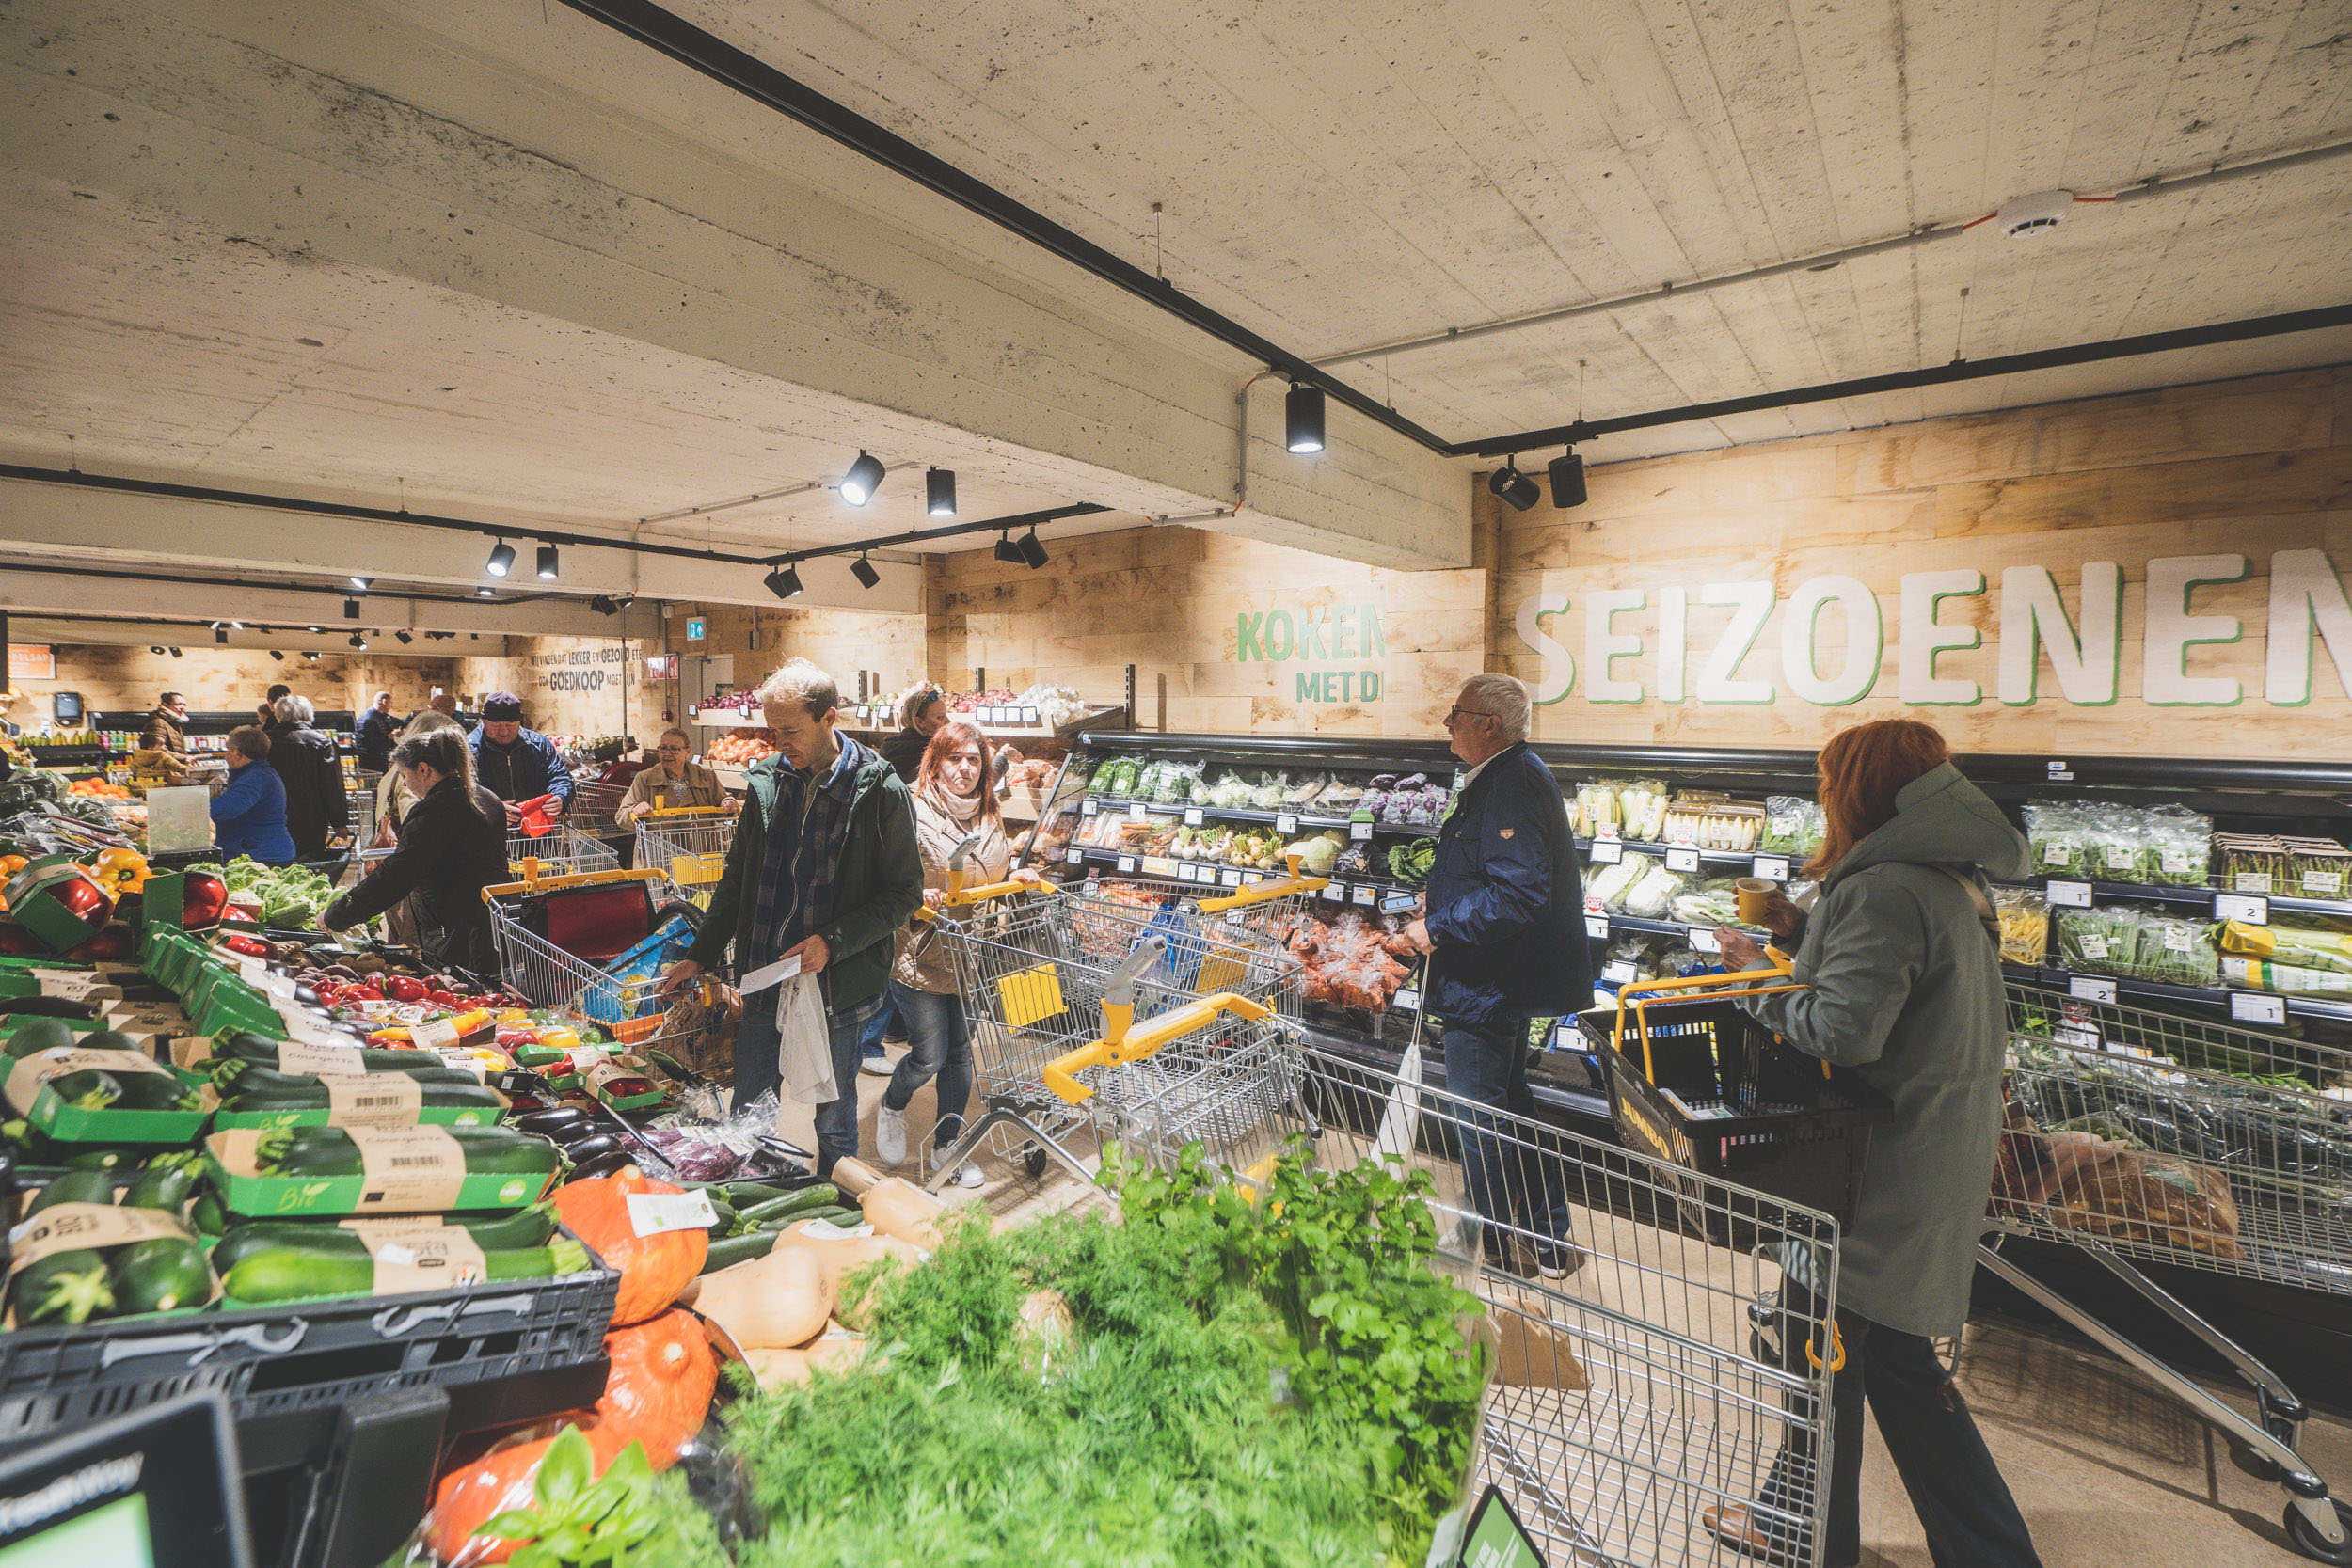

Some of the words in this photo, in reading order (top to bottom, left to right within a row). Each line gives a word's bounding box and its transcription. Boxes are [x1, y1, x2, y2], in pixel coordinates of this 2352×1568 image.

[1237, 604, 1386, 662] KOKEN
[568, 650, 591, 666] LEKKER
[592, 651, 600, 663] EN
[538, 675, 548, 687] OOK
[549, 669, 605, 692] GOEDKOOP
[606, 673, 622, 686] MOET
[1295, 670, 1356, 703] MET
[1360, 670, 1385, 703] D
[1621, 1096, 1671, 1161] JUMBO
